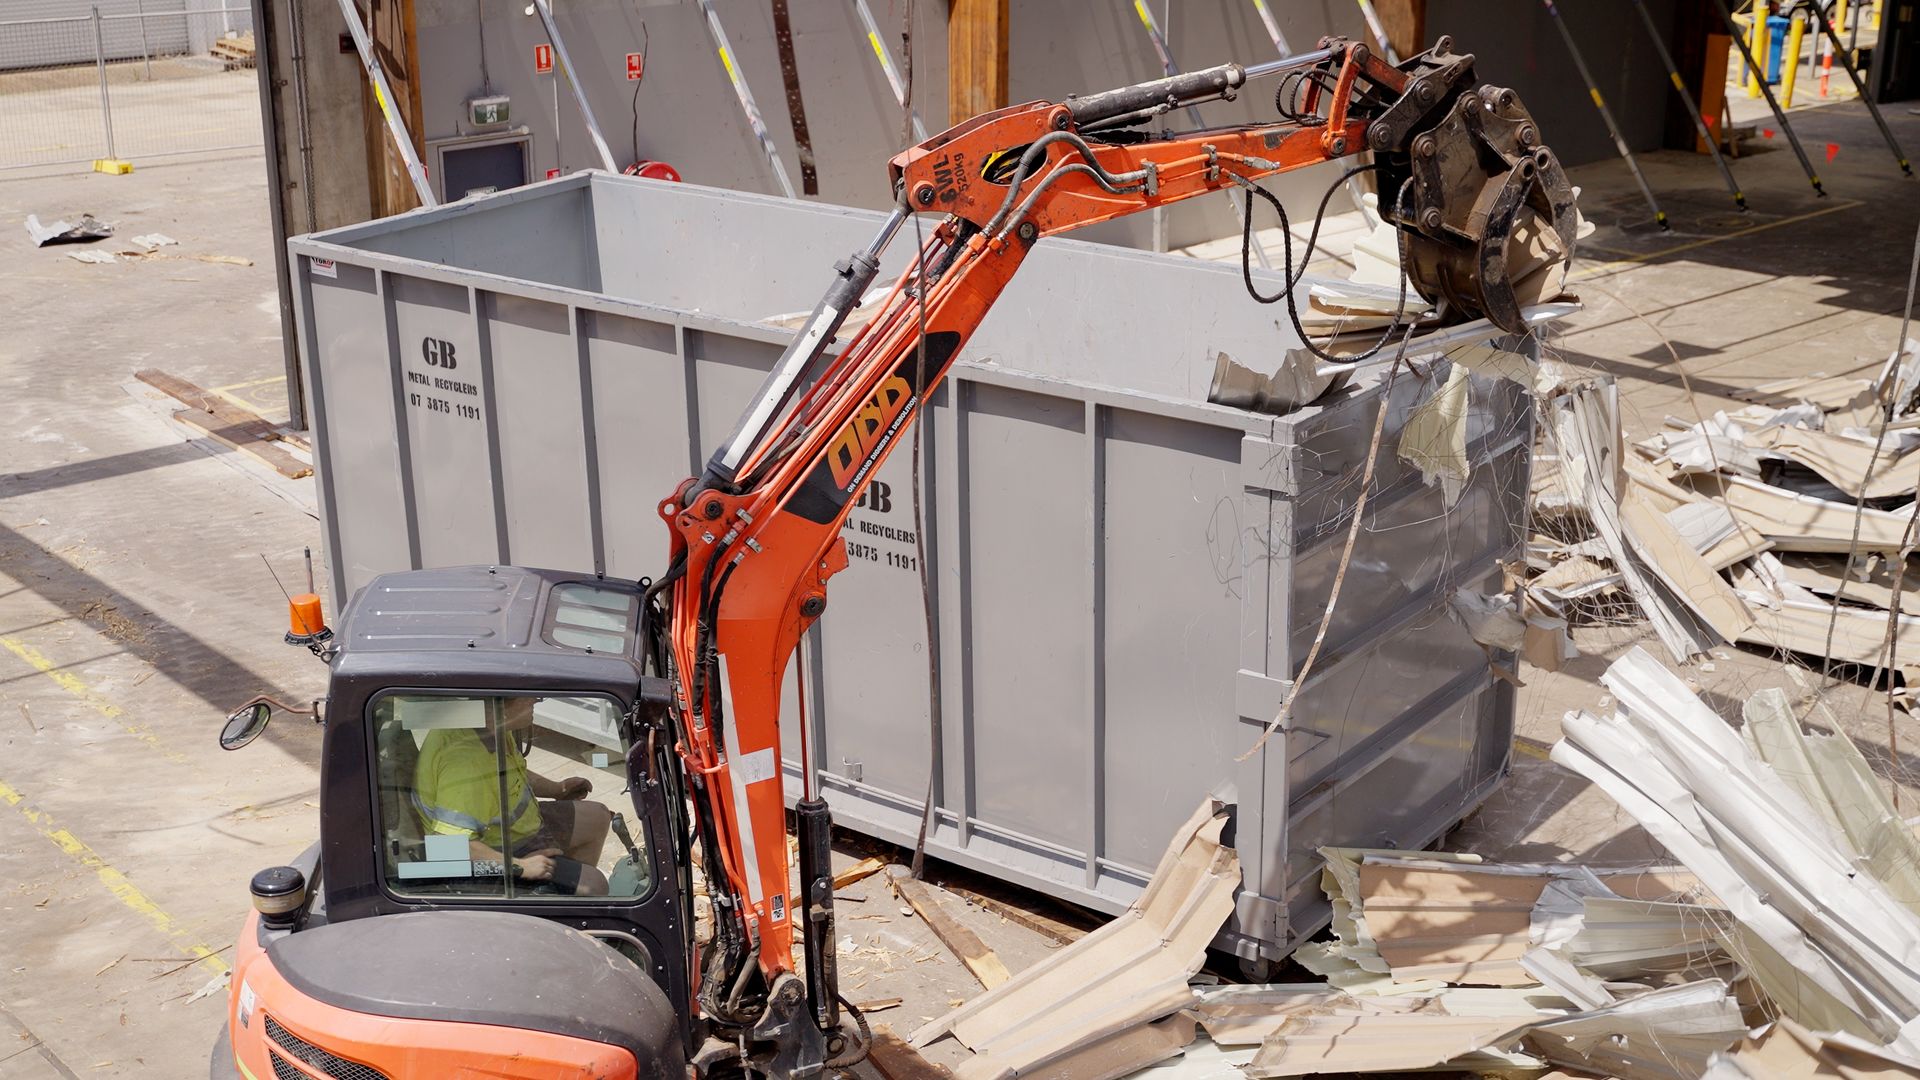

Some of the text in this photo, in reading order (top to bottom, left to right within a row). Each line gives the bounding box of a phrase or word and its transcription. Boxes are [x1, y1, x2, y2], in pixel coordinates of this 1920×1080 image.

[932, 154, 957, 203] SWL
[954, 153, 969, 193] 520kg
[422, 337, 457, 370] GB
[408, 371, 478, 396] METAL RECYCLERS
[411, 393, 480, 421] 07 3875 1191
[847, 483, 857, 494] ON
[855, 460, 873, 484] DEMAND
[870, 435, 891, 462] DIGGERS
[860, 520, 916, 544] RECYCLERS
[848, 541, 917, 572] 3875 1191
